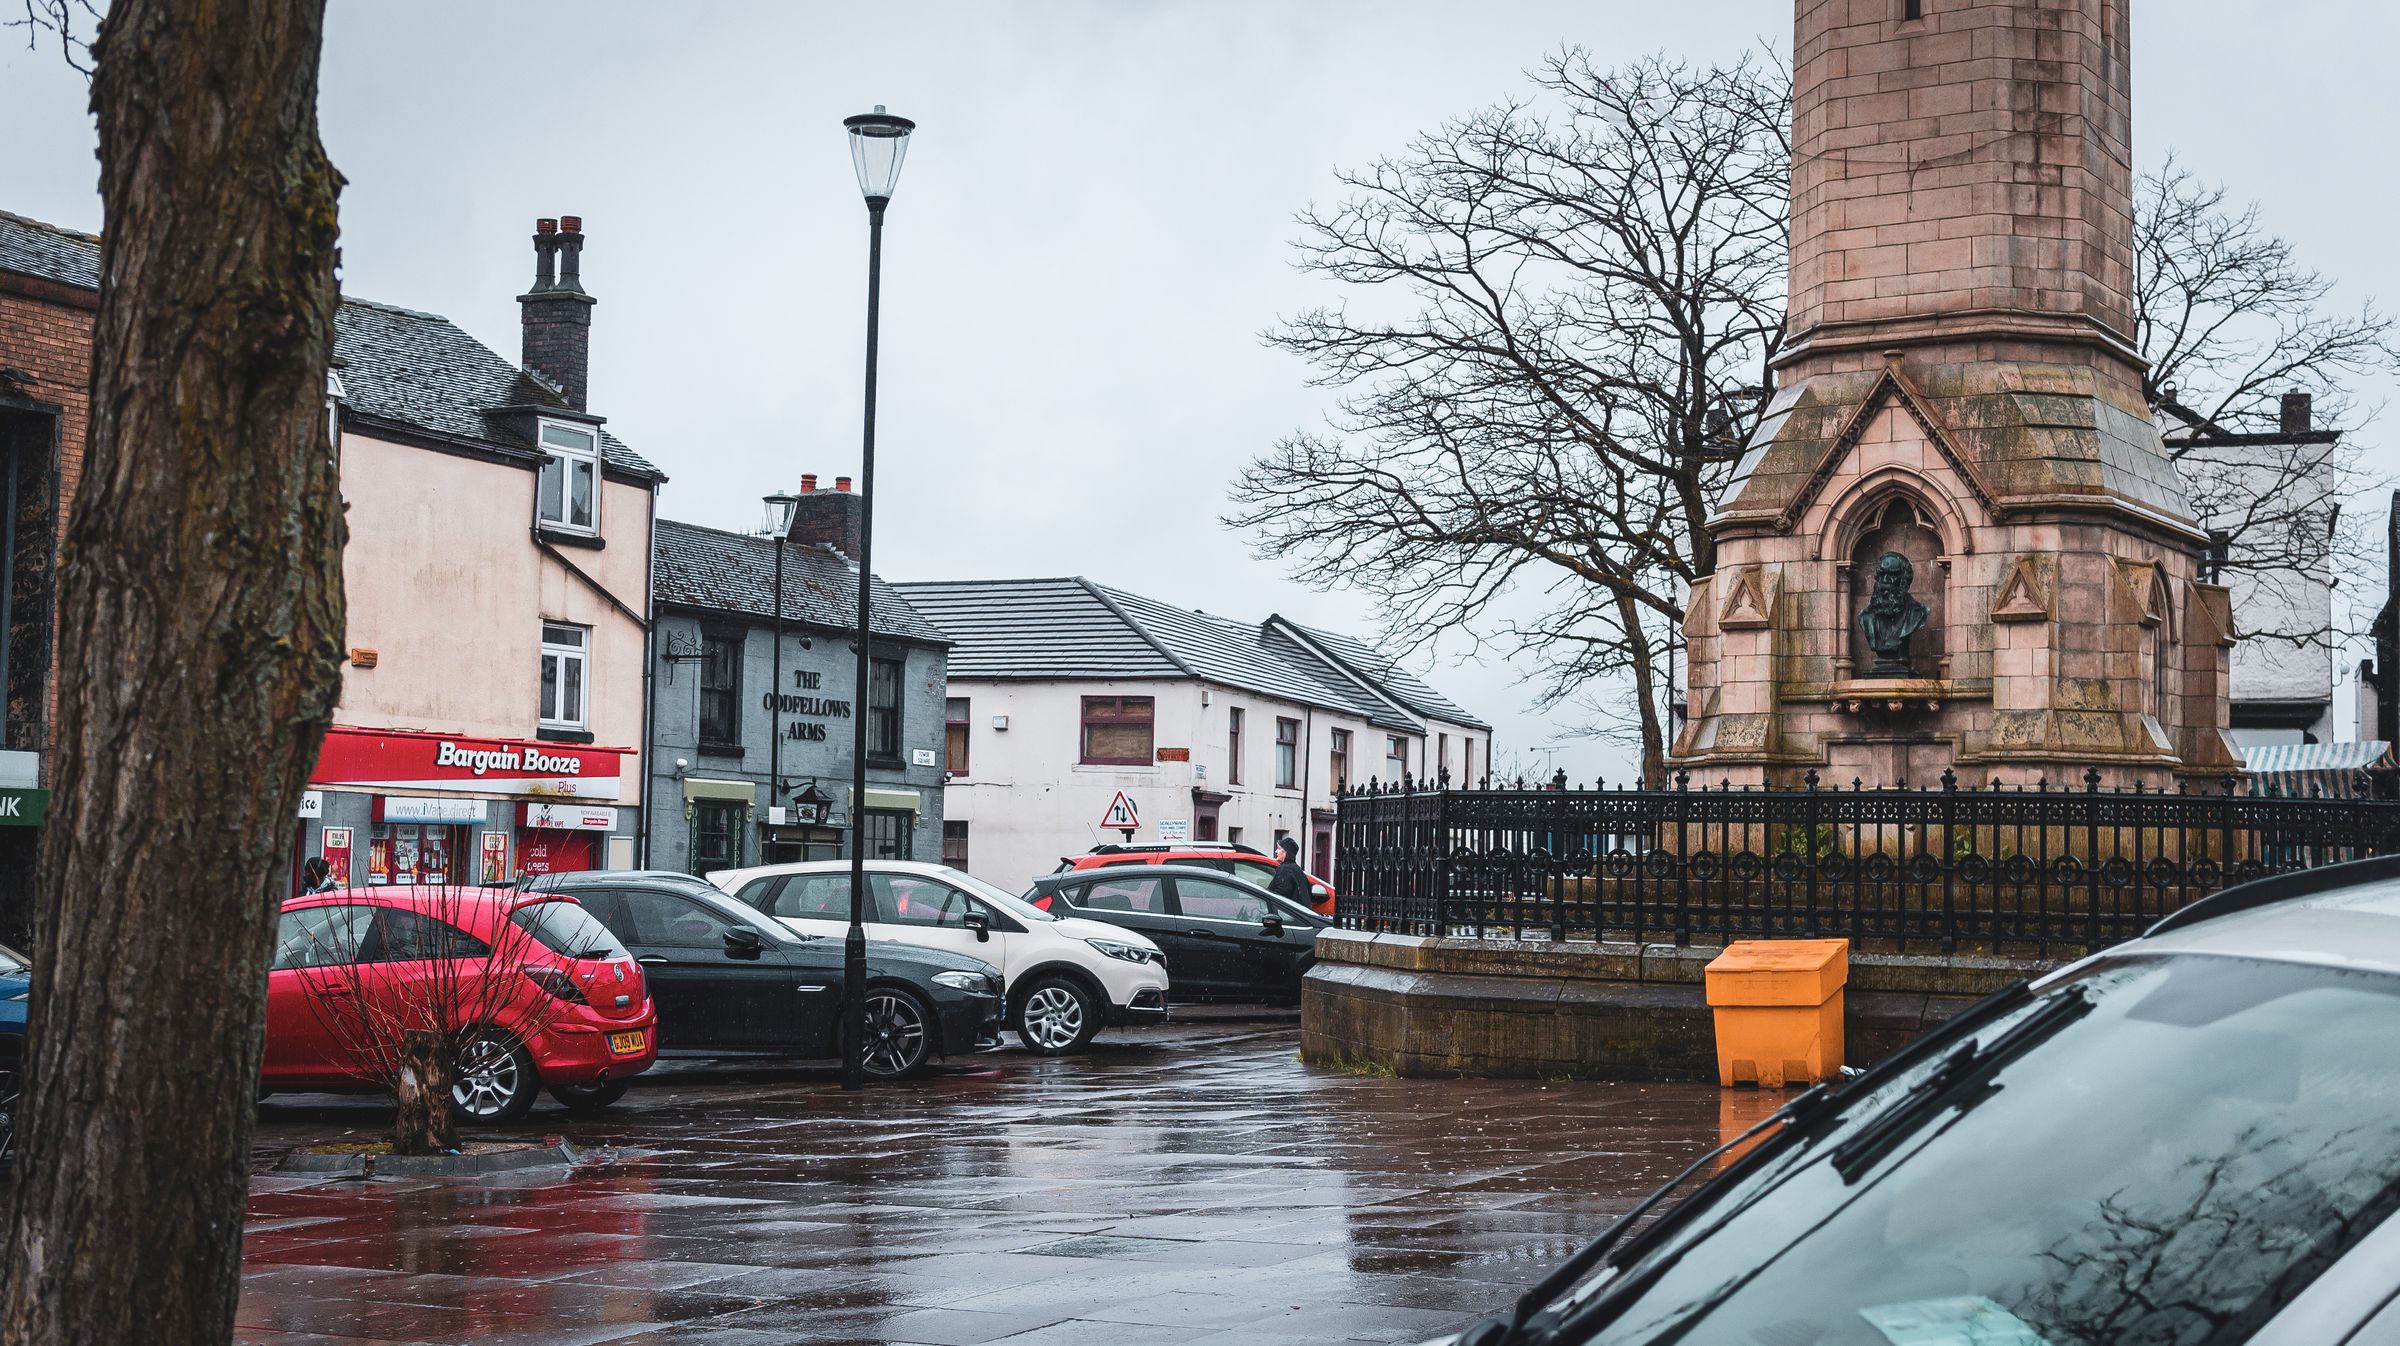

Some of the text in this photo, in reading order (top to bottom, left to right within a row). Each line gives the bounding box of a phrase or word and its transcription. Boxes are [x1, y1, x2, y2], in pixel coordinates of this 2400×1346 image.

[794, 669, 821, 689] THE
[787, 721, 826, 741] ARMS
[437, 741, 580, 775] Bargain Booze
[557, 781, 577, 793] Plus
